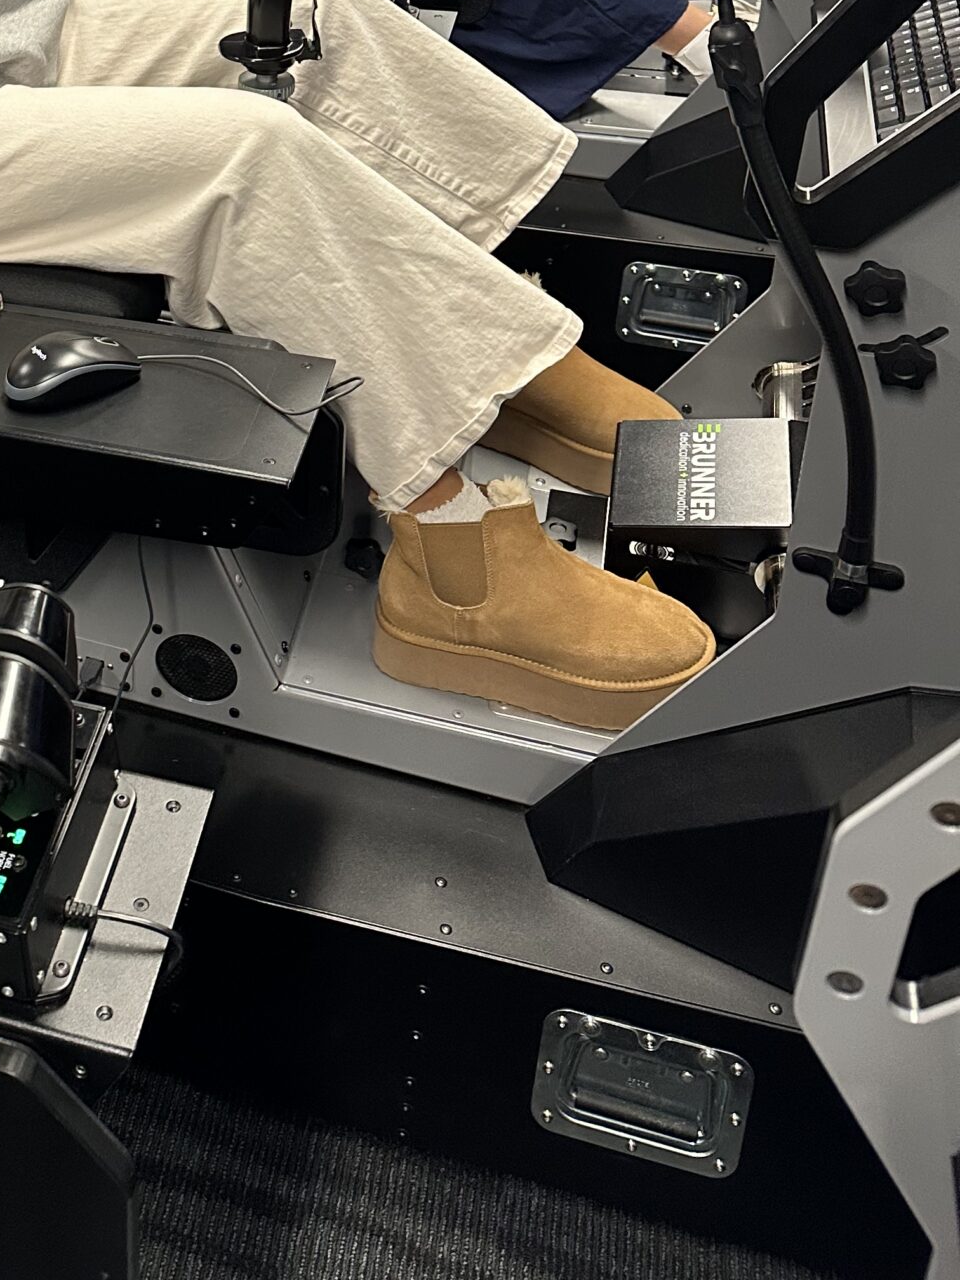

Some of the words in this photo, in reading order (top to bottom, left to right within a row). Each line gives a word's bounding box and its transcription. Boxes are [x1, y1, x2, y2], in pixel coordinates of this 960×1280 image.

[678, 431, 691, 472] dedication
[691, 424, 721, 522] BRUNNER
[677, 479, 690, 522] innovation
